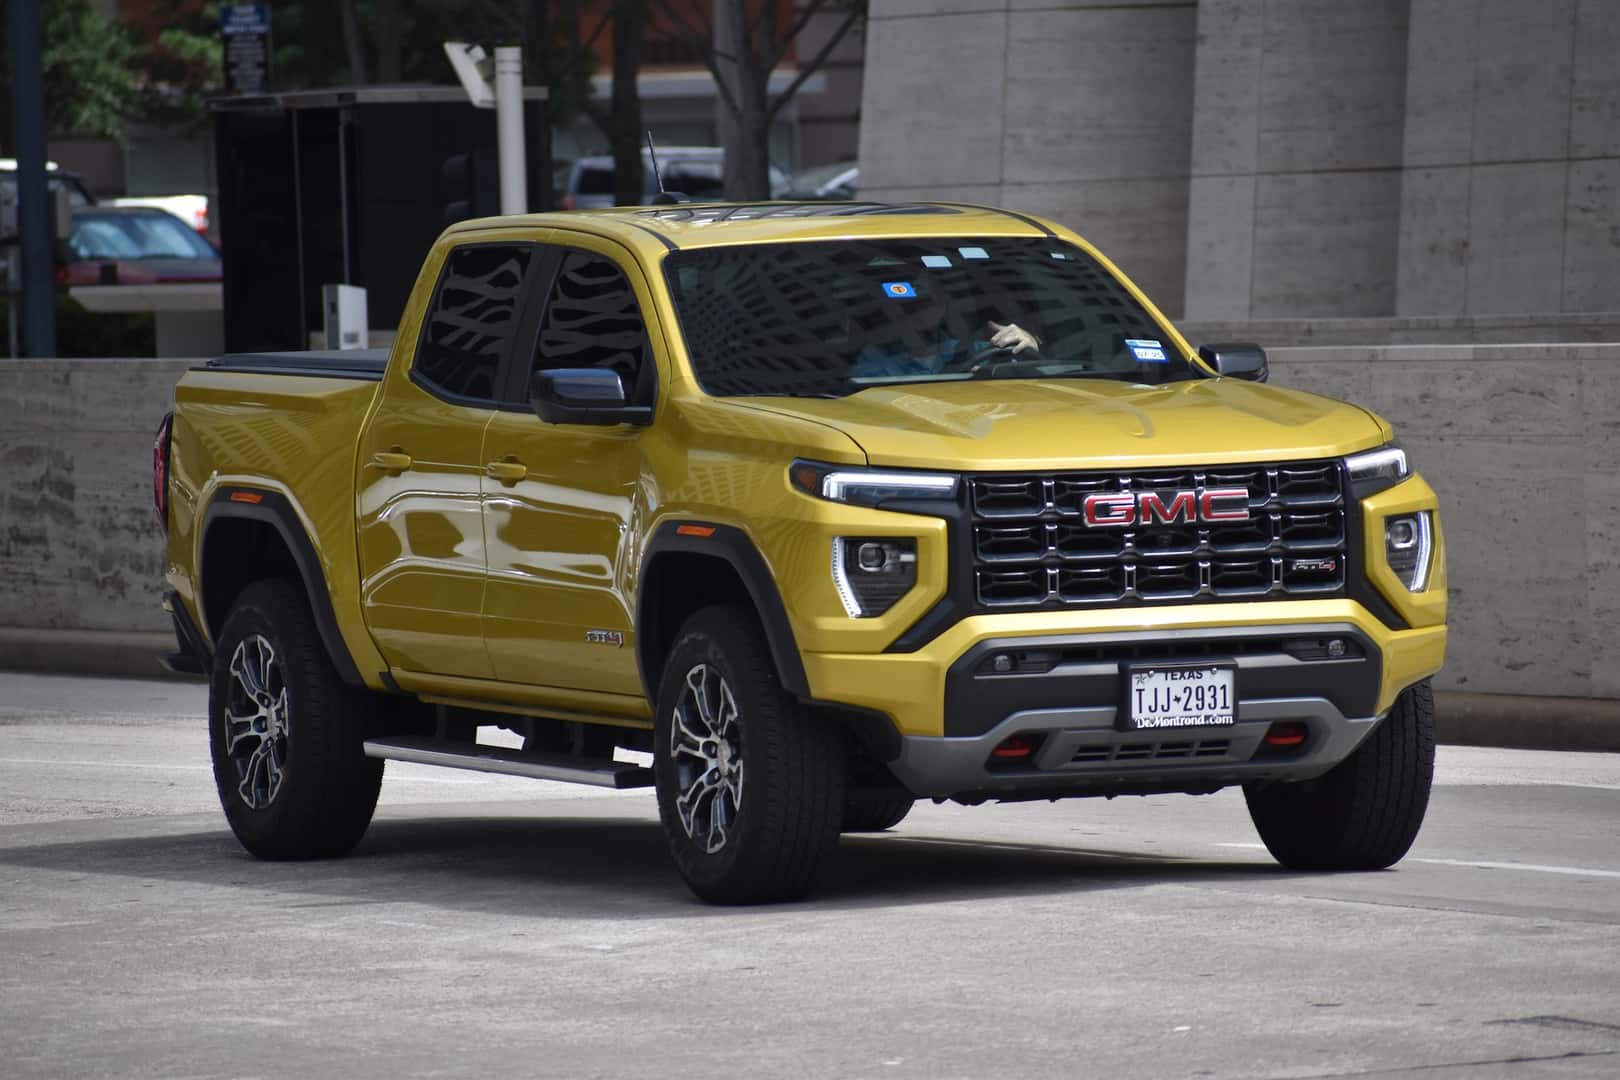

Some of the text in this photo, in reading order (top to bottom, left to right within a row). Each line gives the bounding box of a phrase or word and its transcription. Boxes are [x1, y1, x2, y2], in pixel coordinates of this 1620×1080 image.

[1084, 489, 1250, 527] GMC
[1164, 671, 1204, 681] TEXAS
[1135, 684, 1230, 714] TJJ 2931
[1135, 714, 1234, 728] DeMontrond.com
